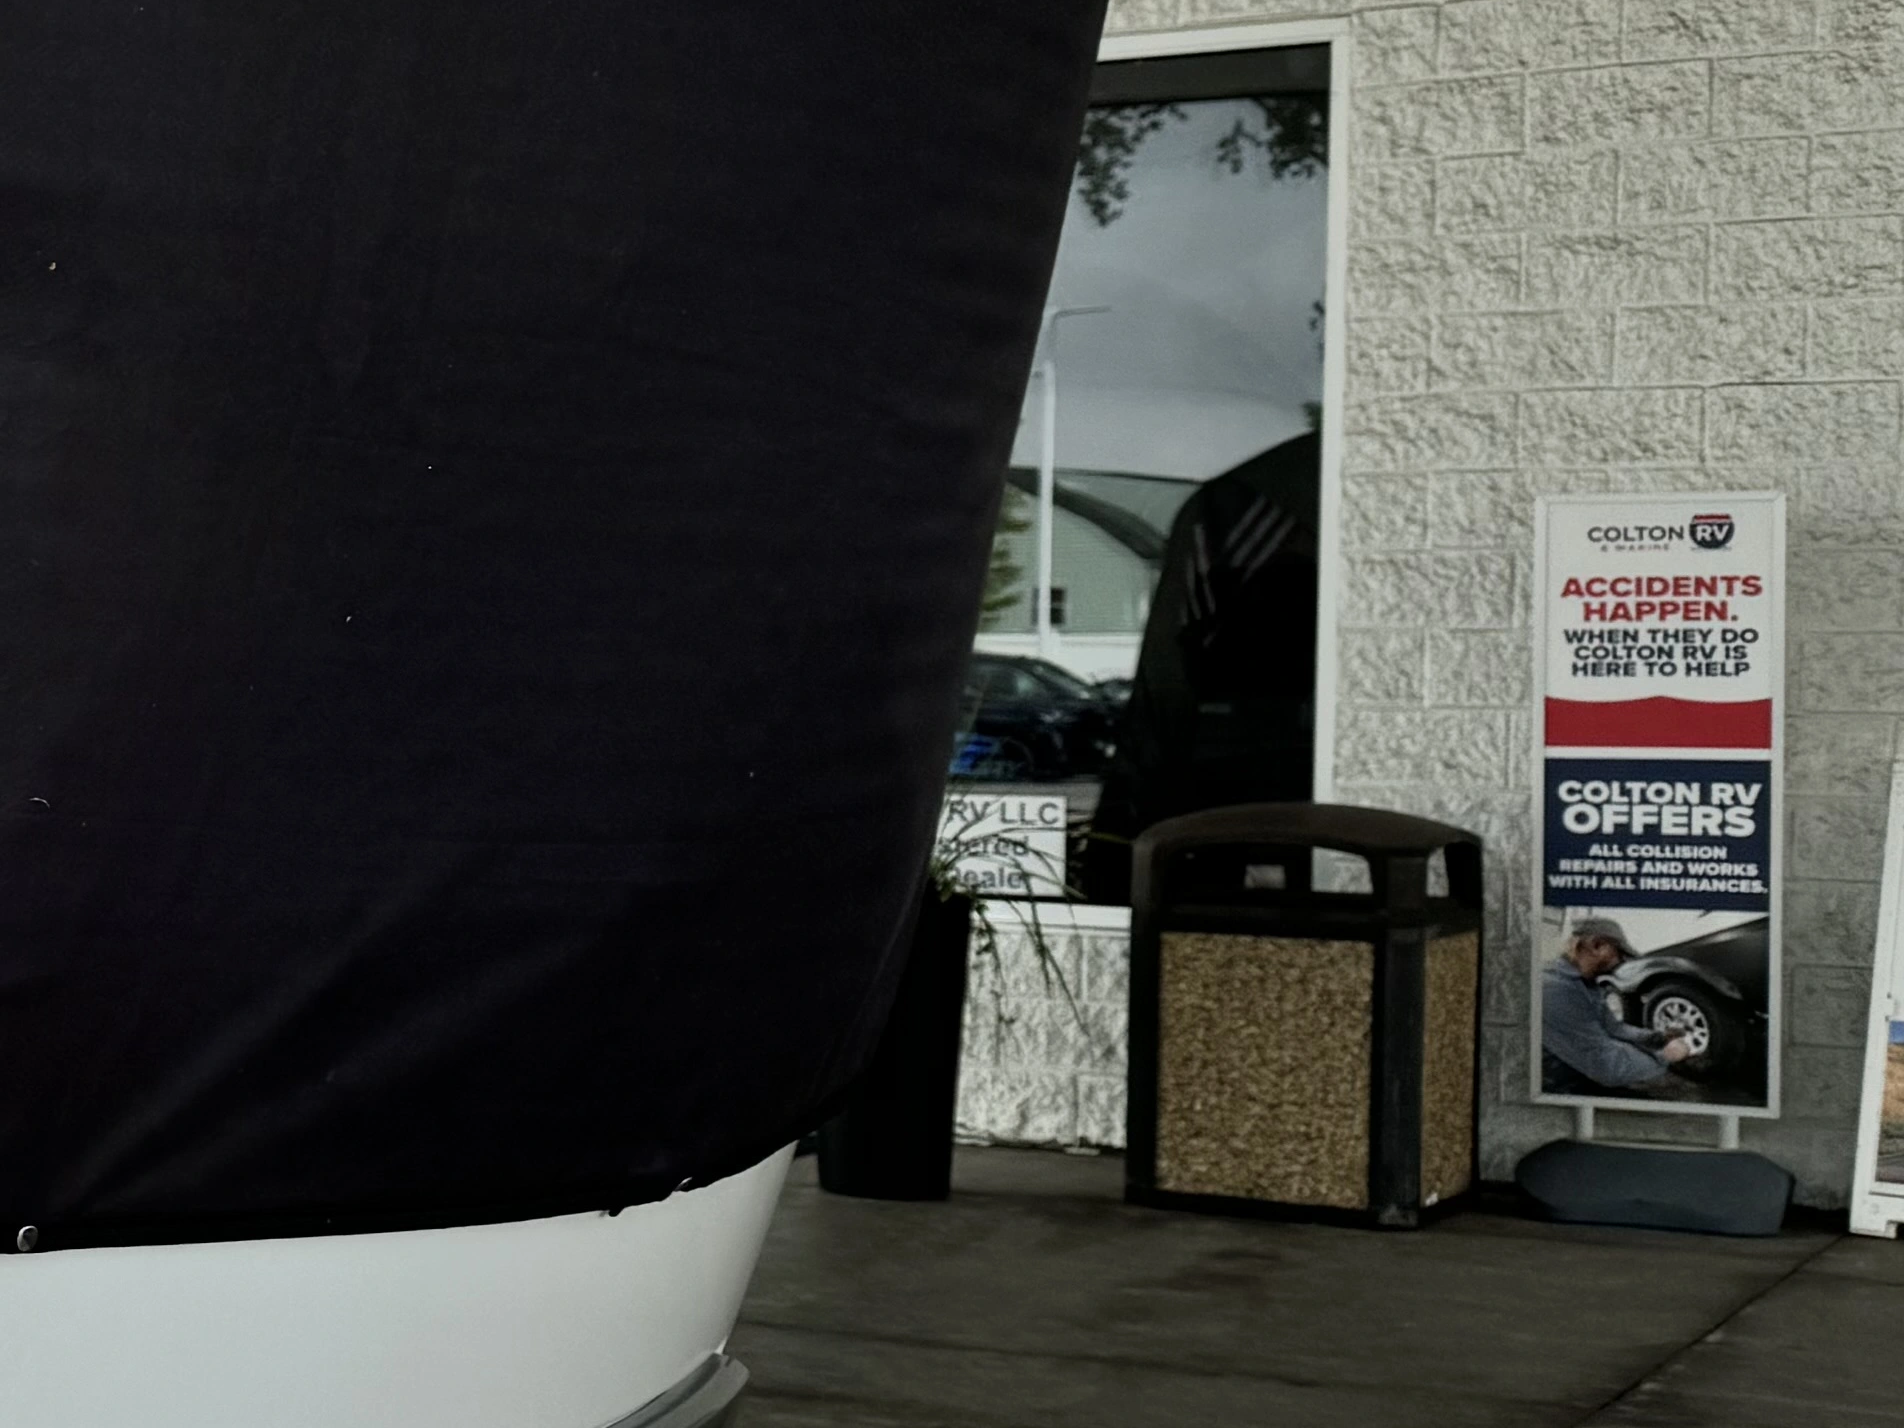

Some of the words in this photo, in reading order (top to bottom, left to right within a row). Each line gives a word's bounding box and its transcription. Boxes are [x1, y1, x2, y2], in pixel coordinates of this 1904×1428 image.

[1587, 525, 1684, 543] COLTON
[1695, 524, 1730, 542] RV
[1560, 575, 1763, 598] ACCIDENTS
[1582, 600, 1739, 622] HAPPEN.
[1563, 628, 1639, 644] WHEN
[1647, 628, 1713, 644] THEY
[1721, 628, 1759, 644] DO
[1573, 645, 1674, 661] COLTON
[1682, 645, 1717, 660] RV
[1725, 645, 1748, 660] IS
[1571, 661, 1637, 677] HERE
[1644, 661, 1678, 677] TO
[1684, 661, 1750, 677] HELP
[1557, 780, 1701, 804] COLTON
[1710, 782, 1762, 806] RV
[948, 799, 991, 823] RV
[999, 801, 1060, 825] LLC
[1562, 802, 1757, 837] OFFERS
[1588, 843, 1624, 858] ALL
[1626, 844, 1728, 860] COLLISION
[1558, 858, 1638, 873] REPAIRS
[1641, 860, 1685, 875] AND
[1687, 862, 1759, 877] WORKS
[1548, 874, 1598, 889] WITH
[1600, 875, 1637, 890] ALL
[1639, 876, 1769, 894] INSURANCES.
